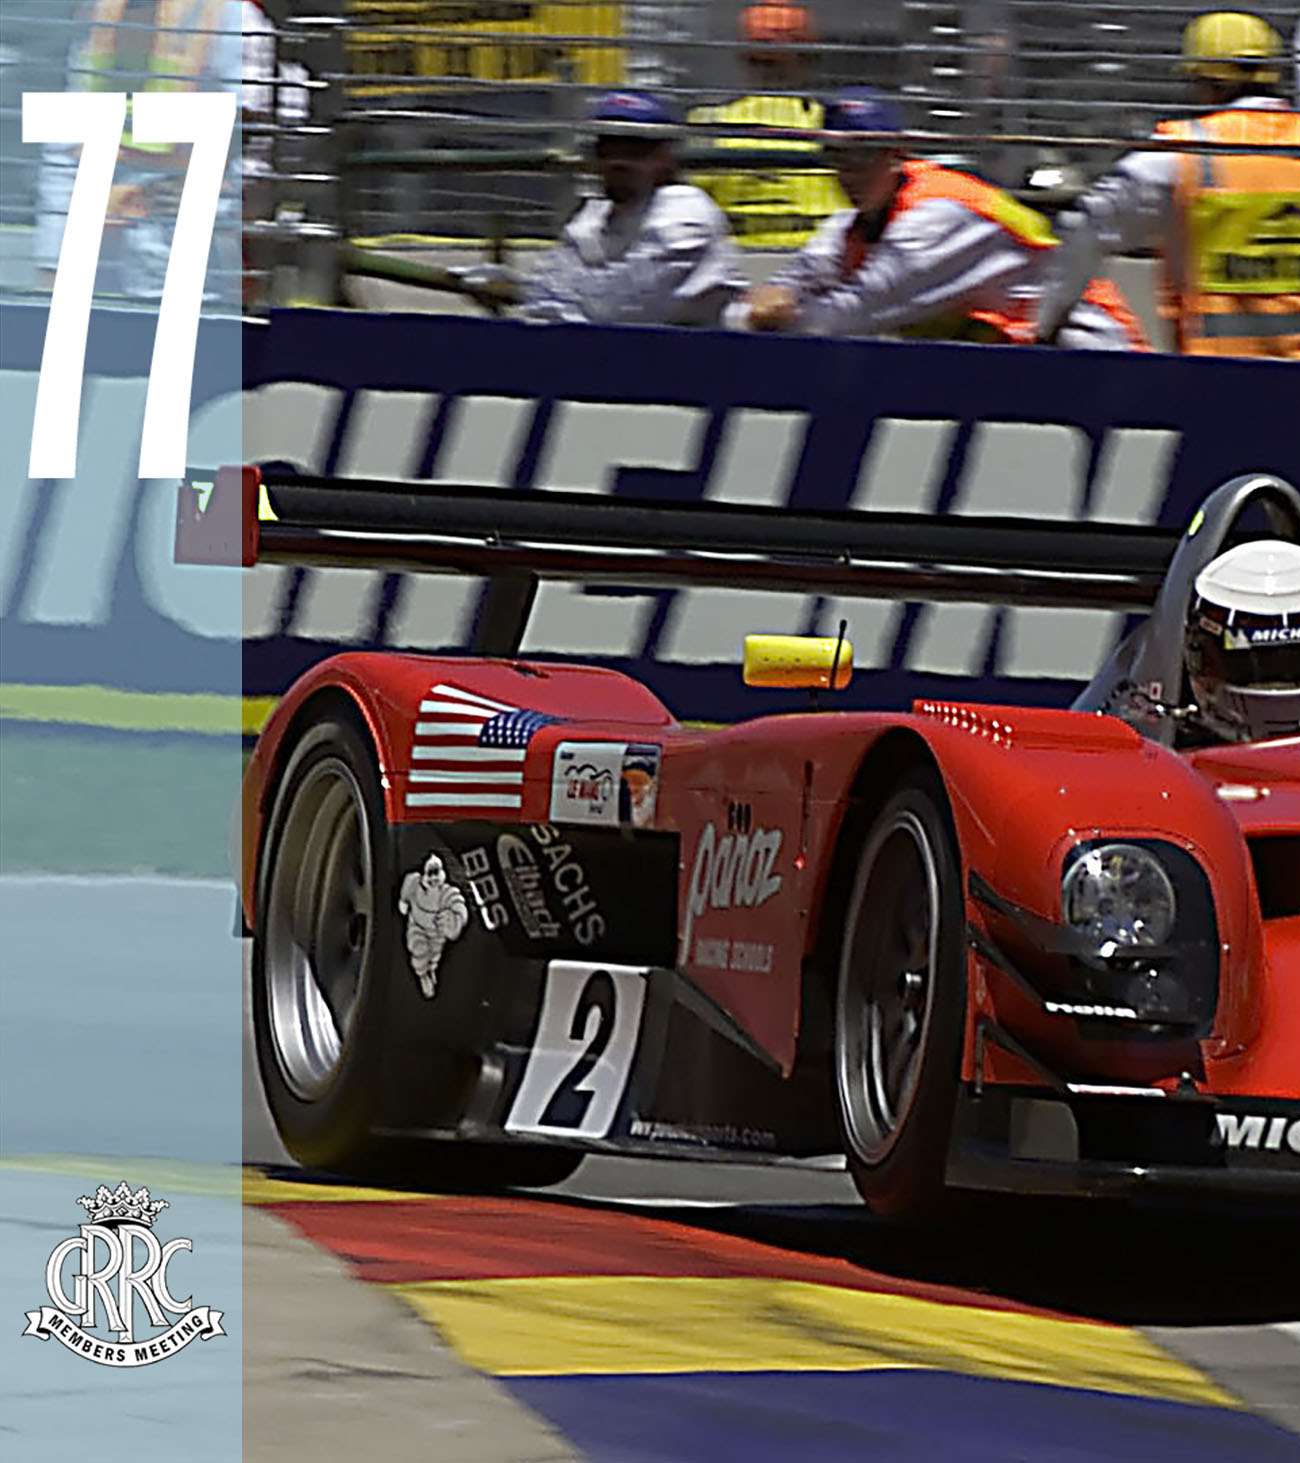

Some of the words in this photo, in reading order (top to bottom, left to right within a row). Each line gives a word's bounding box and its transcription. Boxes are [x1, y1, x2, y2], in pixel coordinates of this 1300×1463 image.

[0, 368, 1183, 680] ICHELIN
[461, 846, 509, 931] BBS
[531, 824, 606, 946] SACHS
[537, 969, 618, 1129] 2
